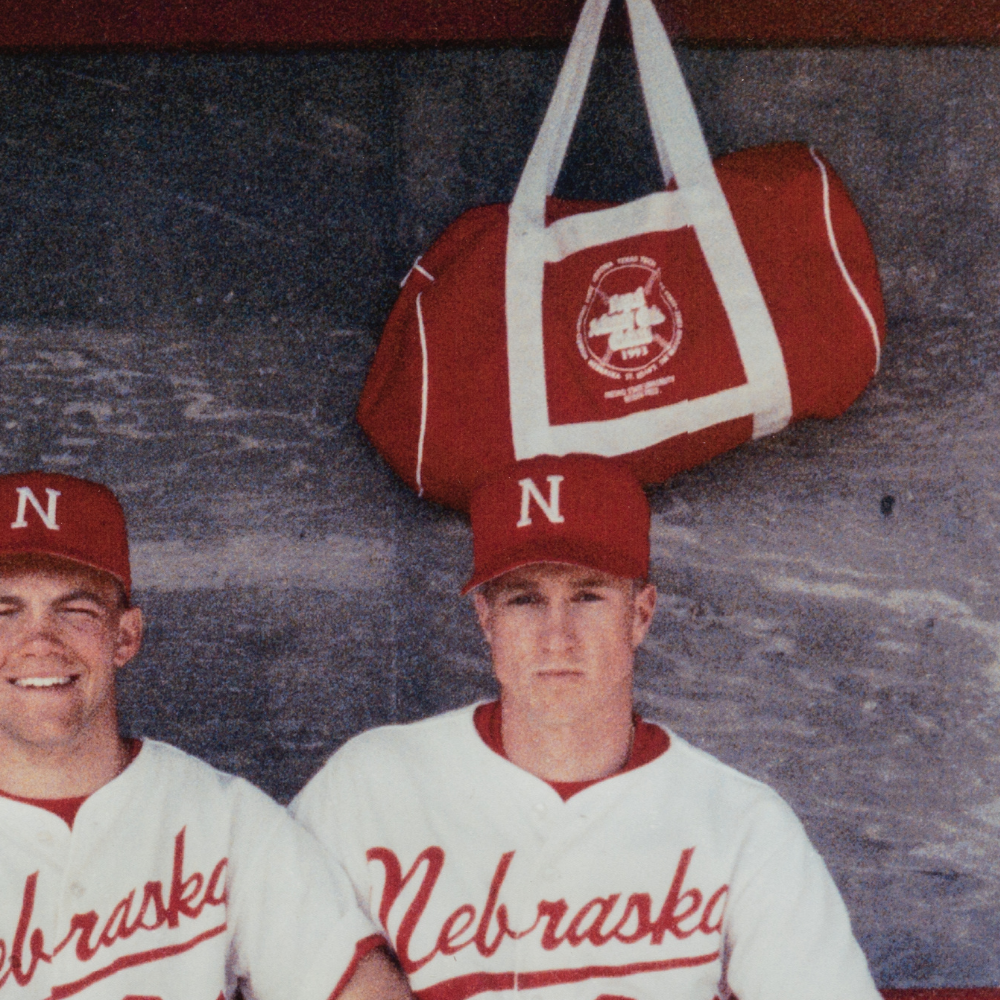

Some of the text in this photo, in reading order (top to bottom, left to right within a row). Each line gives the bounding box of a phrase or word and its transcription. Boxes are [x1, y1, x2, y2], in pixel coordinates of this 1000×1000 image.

[10, 486, 62, 531] N
[516, 474, 566, 528] N
[365, 845, 730, 975] Nebraska
